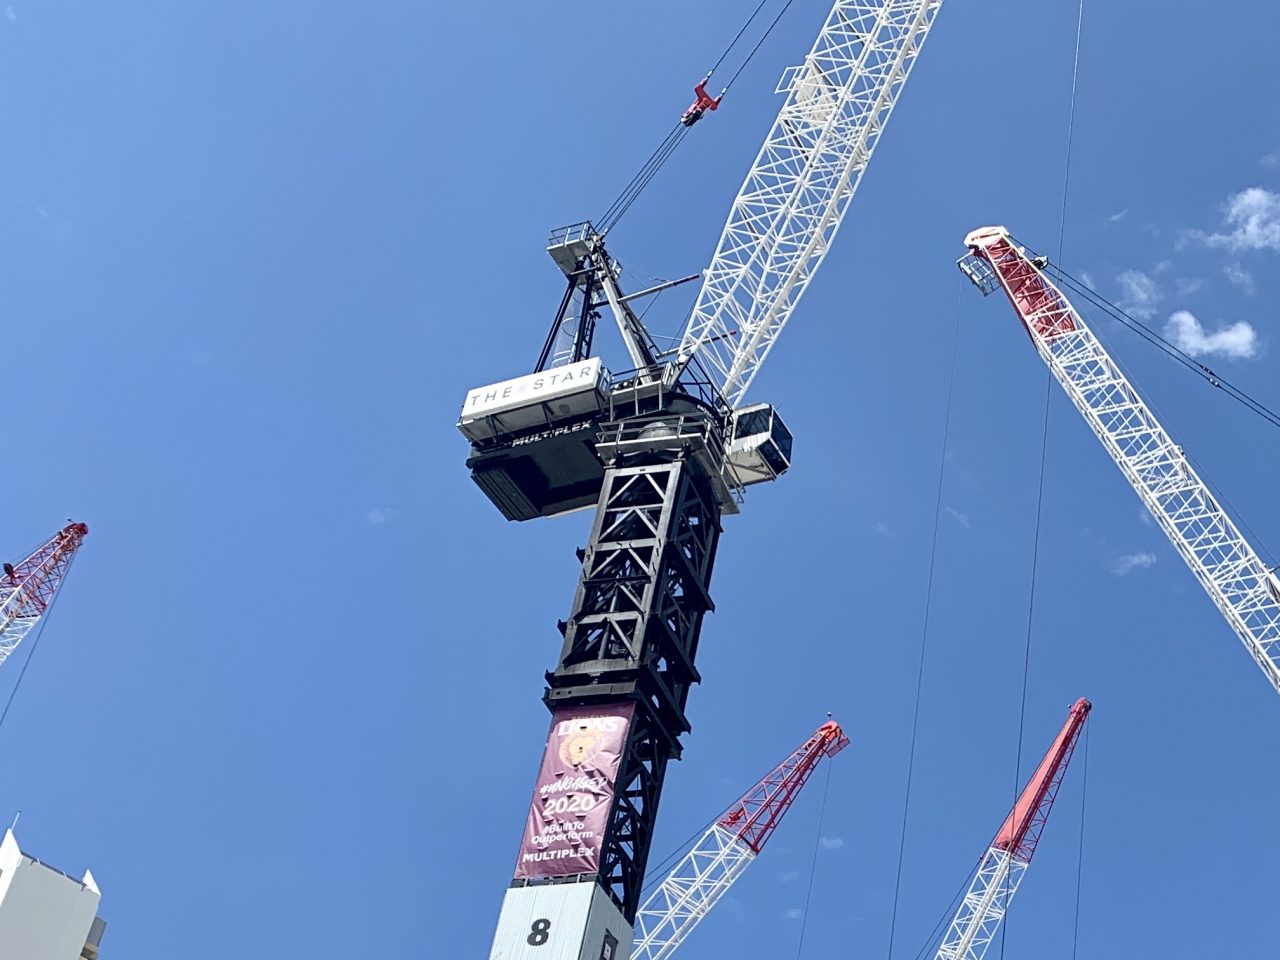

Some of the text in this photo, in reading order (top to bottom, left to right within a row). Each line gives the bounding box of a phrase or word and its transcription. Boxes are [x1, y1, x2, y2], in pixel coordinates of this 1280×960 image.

[470, 365, 592, 407] THE STAR
[511, 420, 592, 447] MULTIPLEX
[542, 796, 595, 816] 2020
[522, 847, 595, 862] MULTIPLEX
[527, 918, 551, 946] 8
